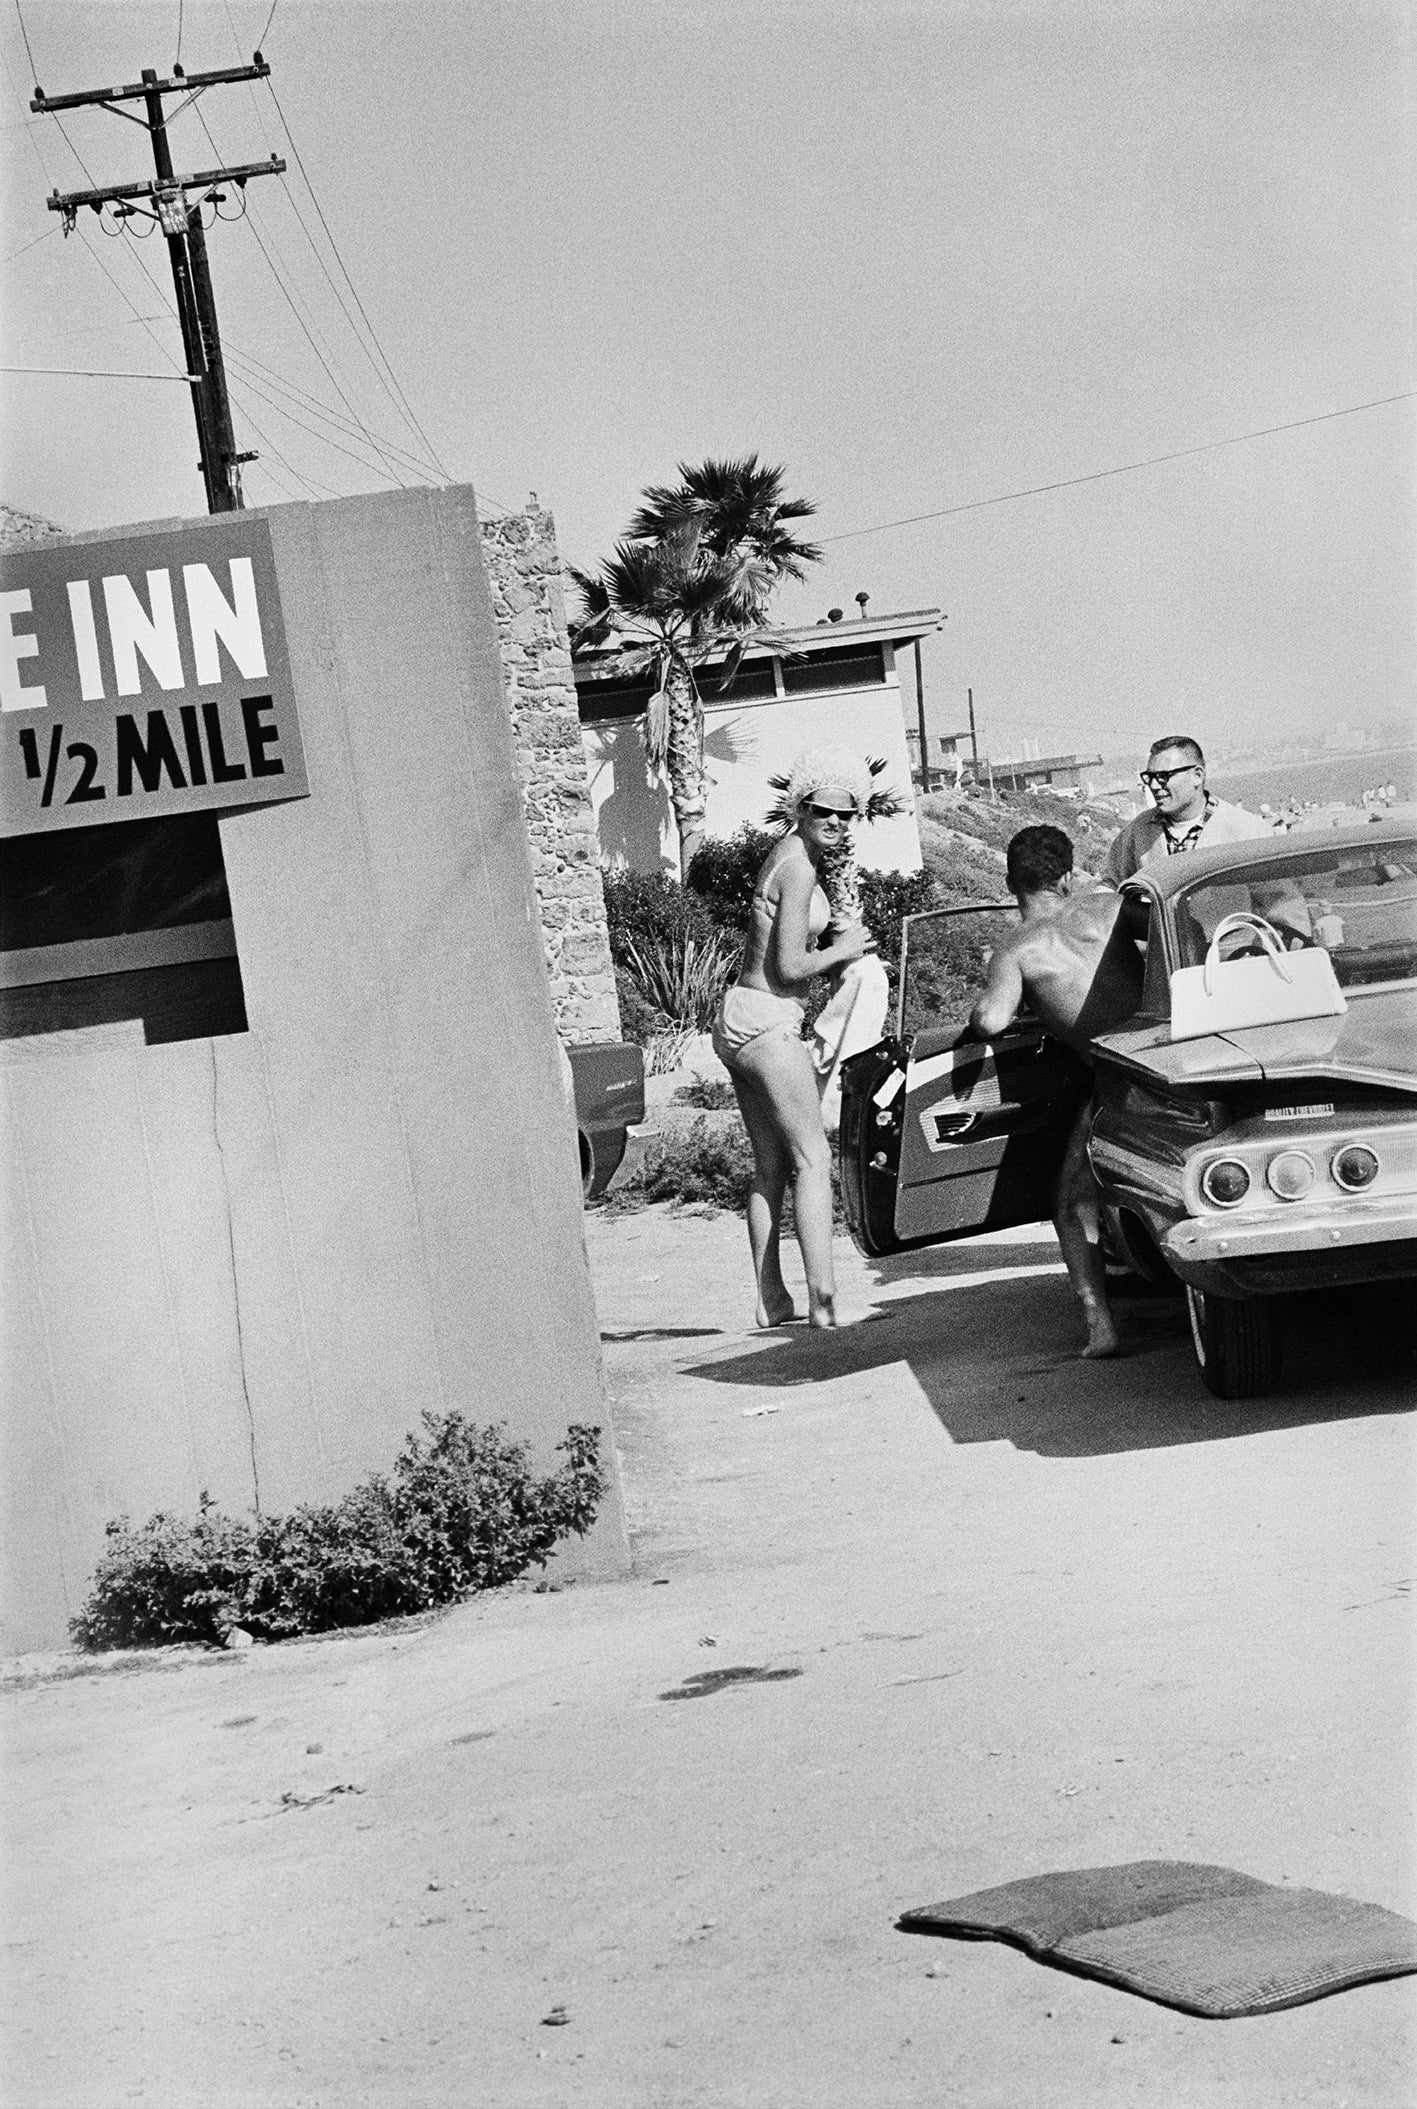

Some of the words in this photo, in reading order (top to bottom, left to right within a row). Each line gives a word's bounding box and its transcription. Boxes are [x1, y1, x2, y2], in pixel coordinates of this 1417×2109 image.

[66, 556, 269, 701] INN
[19, 724, 106, 808] 1/2
[116, 694, 285, 797] MILE
